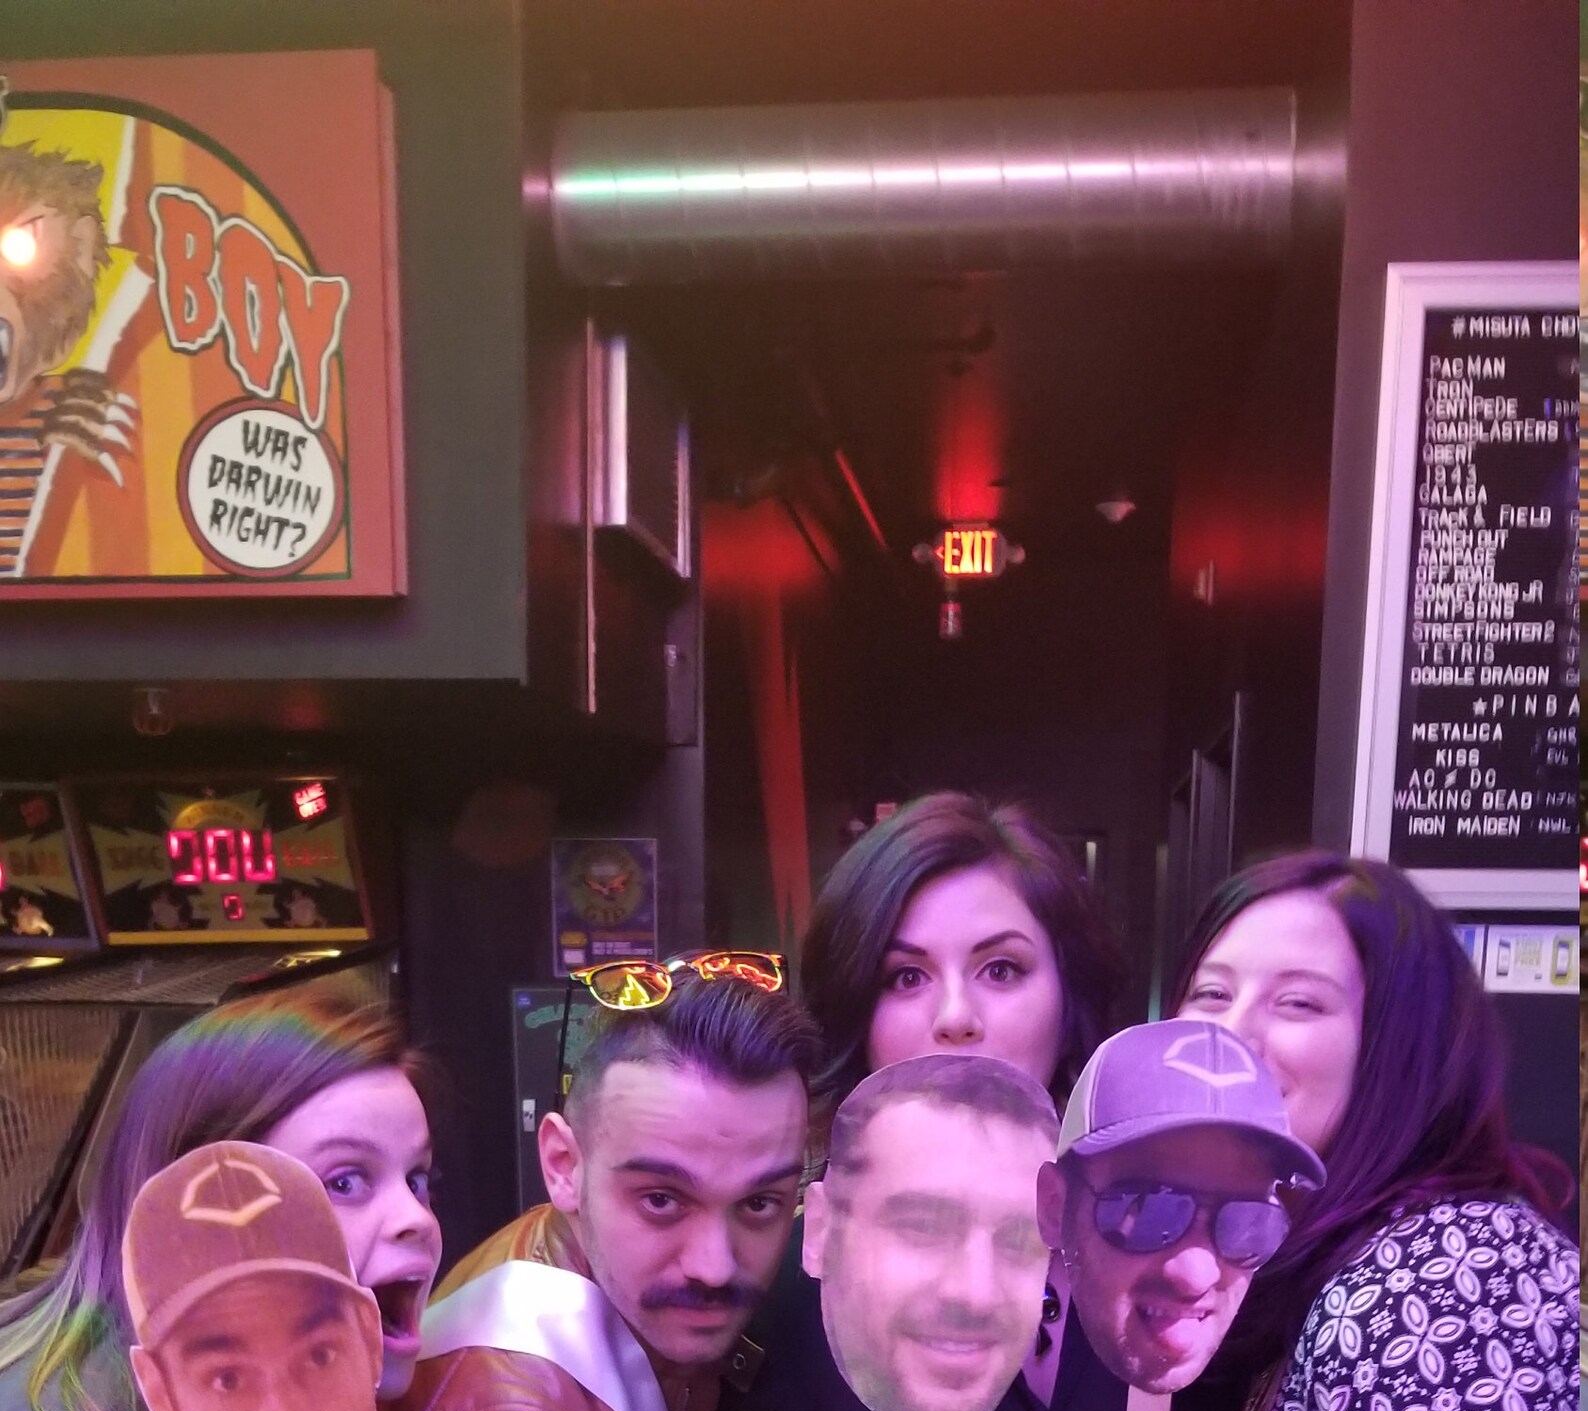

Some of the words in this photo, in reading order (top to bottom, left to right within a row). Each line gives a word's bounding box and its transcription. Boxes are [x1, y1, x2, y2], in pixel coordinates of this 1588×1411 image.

[148, 184, 350, 431] BOY
[1541, 315, 1580, 338] CHU
[1426, 378, 1474, 401] TRON
[1425, 395, 1518, 420] CENTIPEDE
[1425, 418, 1559, 442] ROADBLASTERS
[242, 419, 308, 472] WAS
[1423, 441, 1476, 465] QBERT
[208, 454, 322, 518] DARWIN
[1419, 483, 1488, 505] GALAGA
[209, 498, 307, 558] RIGHT?
[1418, 507, 1469, 530] TRACK
[1500, 504, 1552, 528] FIELD
[1421, 529, 1474, 549] PUNCH
[1477, 529, 1509, 549] OUT
[943, 530, 997, 574] EXIT
[1418, 548, 1496, 567] RAMPAGE
[1416, 566, 1450, 583] OFF
[1454, 565, 1495, 584] ROAD
[1522, 580, 1544, 605] JR
[1414, 600, 1516, 621] SIMPSONS
[1418, 642, 1495, 665] TETRIS
[1411, 666, 1476, 686] DOUBLE
[1481, 664, 1550, 686] DRAGON
[1435, 748, 1481, 768] KISS
[1394, 789, 1473, 812] WALKING
[1482, 789, 1533, 812] DEAD
[1409, 815, 1447, 838] IRON
[1457, 815, 1521, 838] MAIDEN
